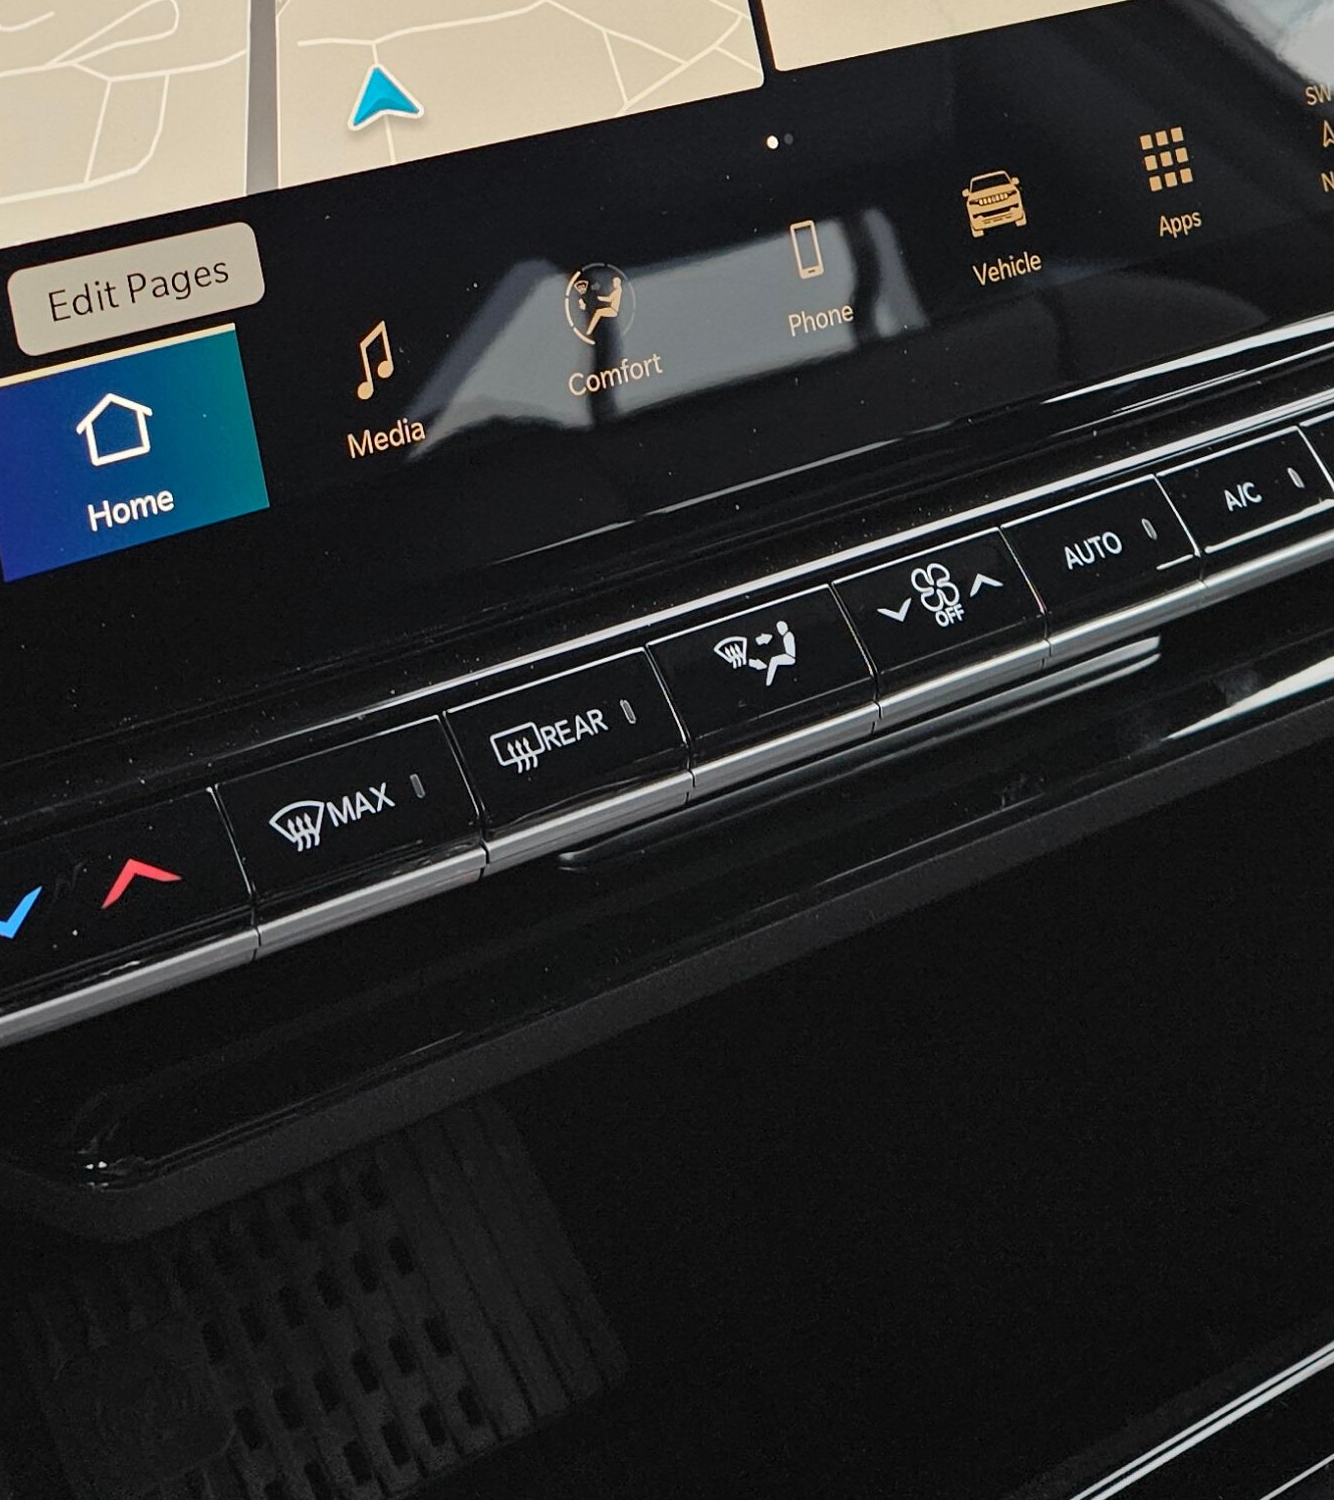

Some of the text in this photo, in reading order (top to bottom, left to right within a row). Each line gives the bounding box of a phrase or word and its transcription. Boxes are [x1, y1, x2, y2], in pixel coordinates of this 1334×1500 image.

[1306, 83, 1332, 106] SW
[1158, 206, 1202, 239] Apps
[972, 251, 1042, 287] Vehicle
[48, 257, 230, 324] Edit Pages
[787, 302, 854, 337] Phone
[568, 352, 664, 398] Comfort
[347, 417, 426, 459] Media
[88, 483, 175, 532] Home
[1225, 481, 1263, 511] A/C
[1064, 531, 1122, 570] AUTO
[935, 604, 965, 627] OFF
[539, 708, 609, 753] REAR
[327, 782, 396, 828] MAX
